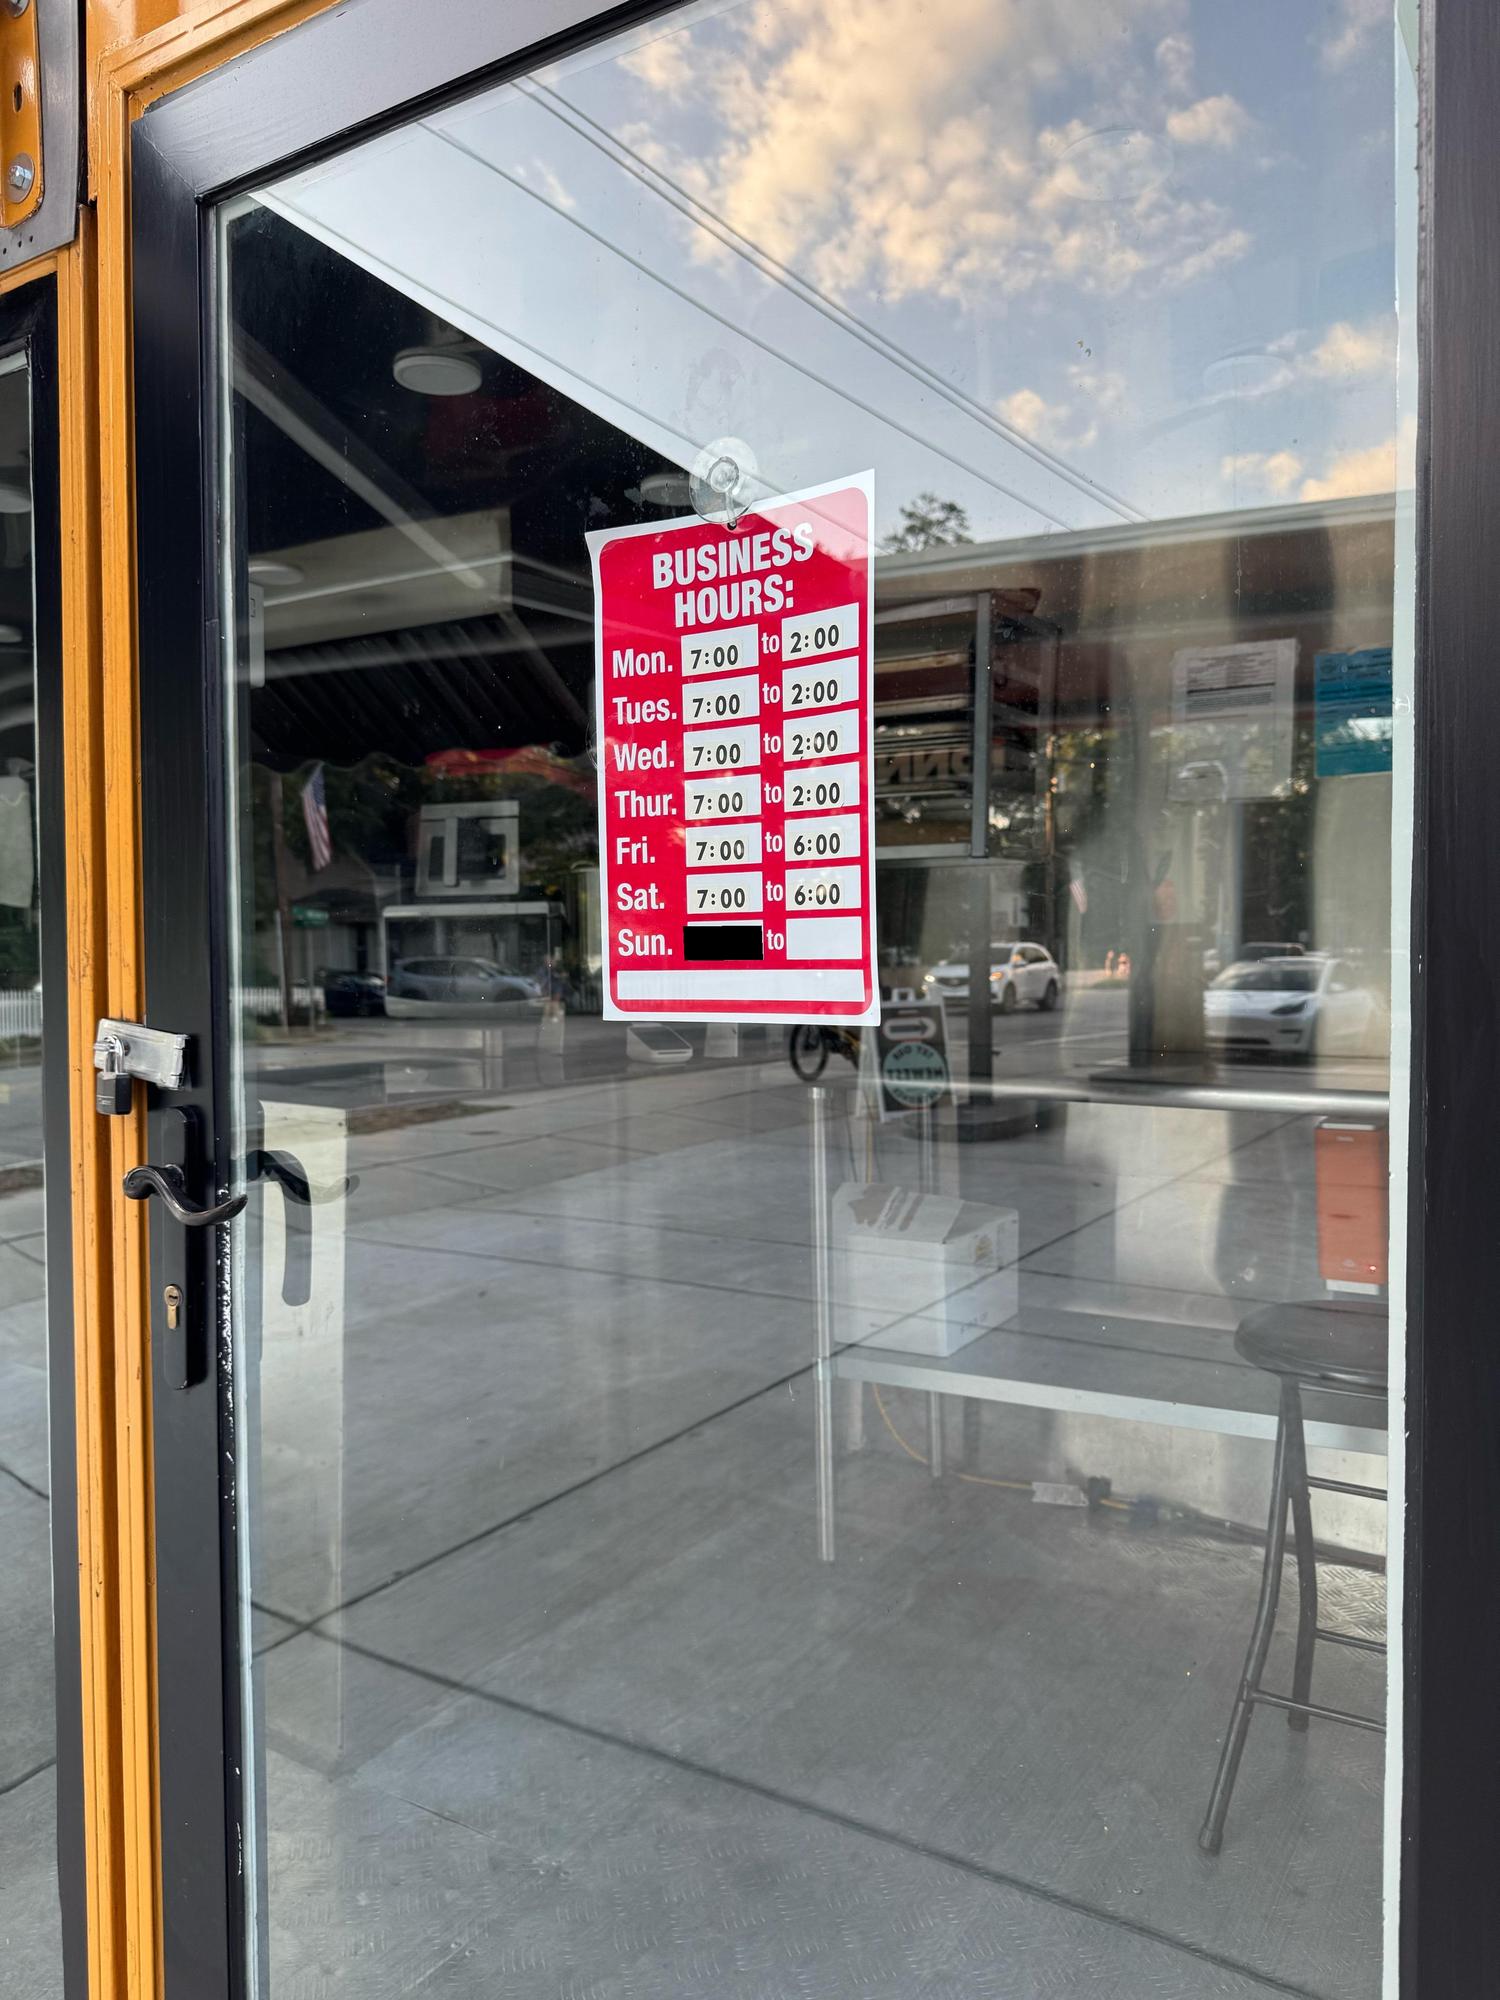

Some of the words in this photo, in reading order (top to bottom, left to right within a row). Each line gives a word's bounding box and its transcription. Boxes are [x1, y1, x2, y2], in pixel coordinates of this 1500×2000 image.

[653, 522, 813, 589] BUSINESS
[674, 574, 793, 628] HOURS:
[612, 649, 673, 678] Mon.
[691, 645, 738, 669] 7:00
[761, 633, 779, 654] to
[790, 625, 839, 653] 2:00
[612, 697, 676, 725] Tues.
[692, 694, 740, 717] 7:00
[762, 683, 780, 704] to
[792, 679, 838, 704] 2:00
[613, 741, 674, 772] Wed.
[693, 743, 741, 766] 7:00
[763, 733, 781, 754] to
[792, 730, 838, 756] 2:00
[615, 790, 676, 819] Thur.
[694, 792, 743, 814] 7:00
[764, 783, 782, 804] to
[792, 782, 840, 806] 2:00
[616, 836, 655, 864] Fri.
[696, 839, 745, 861] 7:00
[765, 832, 783, 852] to
[794, 832, 841, 855] 6:00
[617, 883, 664, 911] Sat.
[697, 888, 745, 909] 7:00
[766, 881, 783, 902] to
[794, 884, 840, 906] 6:00
[618, 928, 673, 956] Sun.
[766, 930, 784, 950] to
